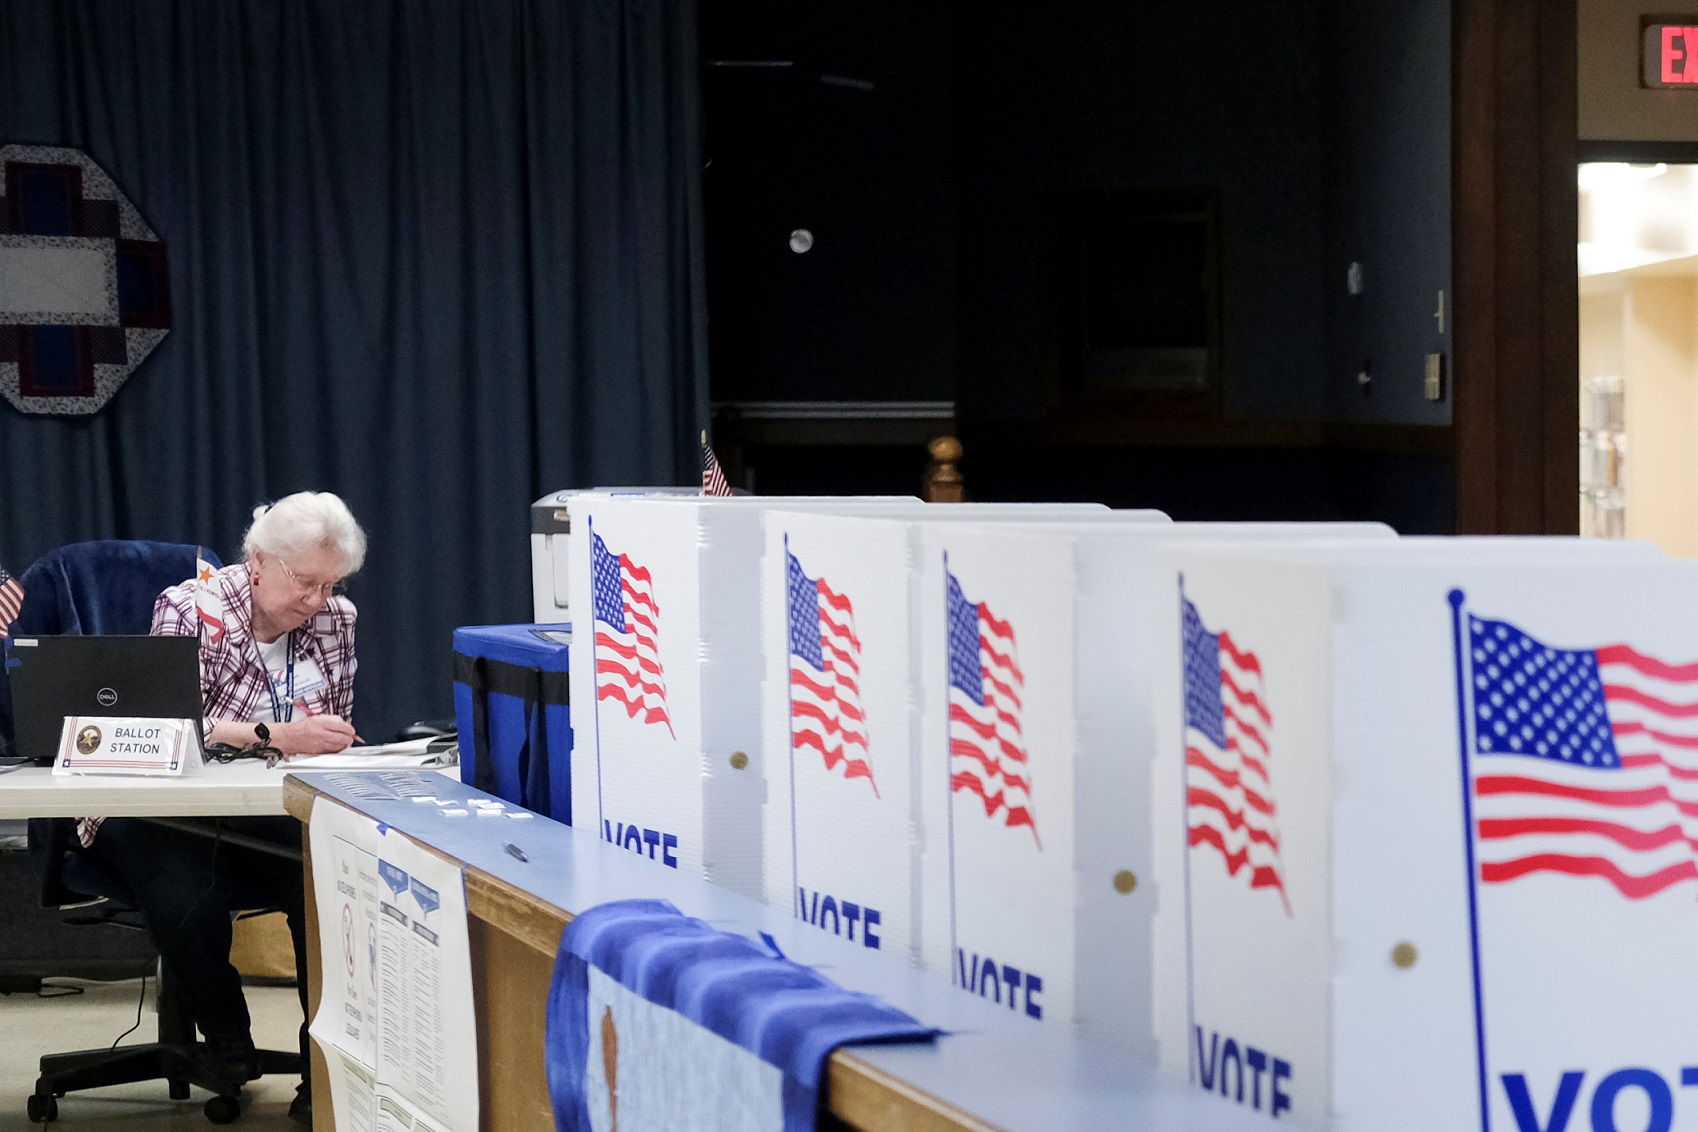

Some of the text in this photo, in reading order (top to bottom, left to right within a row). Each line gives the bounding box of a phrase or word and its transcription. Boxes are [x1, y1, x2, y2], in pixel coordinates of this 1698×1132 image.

[110, 742, 160, 754] STATION
[115, 727, 162, 739] BALLOT
[958, 947, 1043, 1021] VOTE
[1195, 1024, 1292, 1119] VOTE
